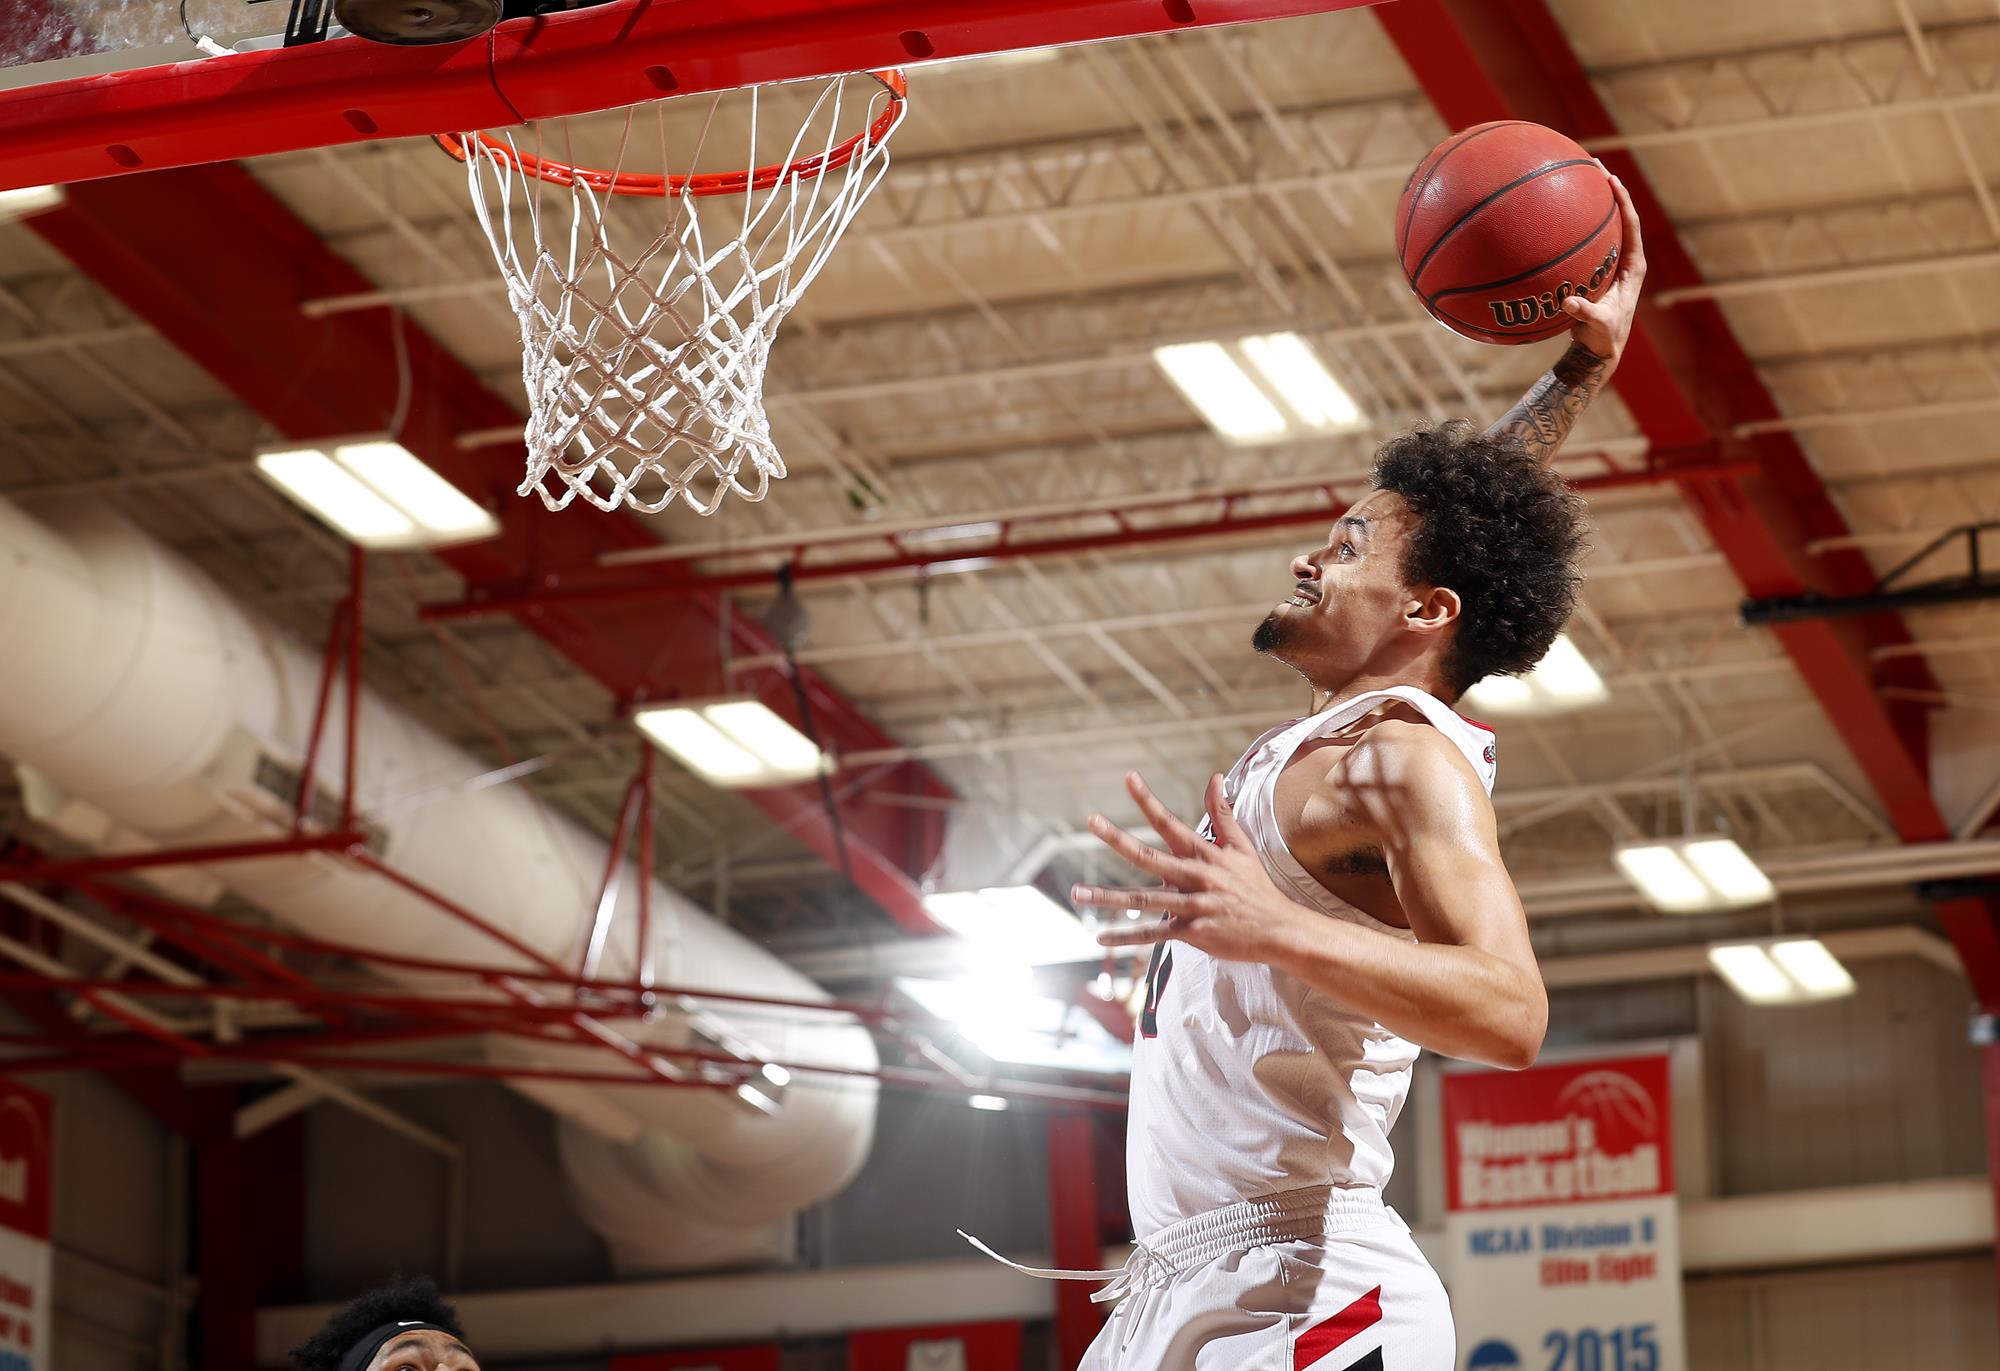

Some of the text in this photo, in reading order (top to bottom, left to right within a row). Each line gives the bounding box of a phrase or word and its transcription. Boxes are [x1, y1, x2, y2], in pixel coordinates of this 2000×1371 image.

[1459, 1144, 1659, 1206] Basketball
[1469, 1228, 1532, 1255] NCAA
[1541, 1223, 1631, 1250] Division
[1540, 1252, 1657, 1287] Elite Eight
[1544, 1323, 1660, 1371] 2015
